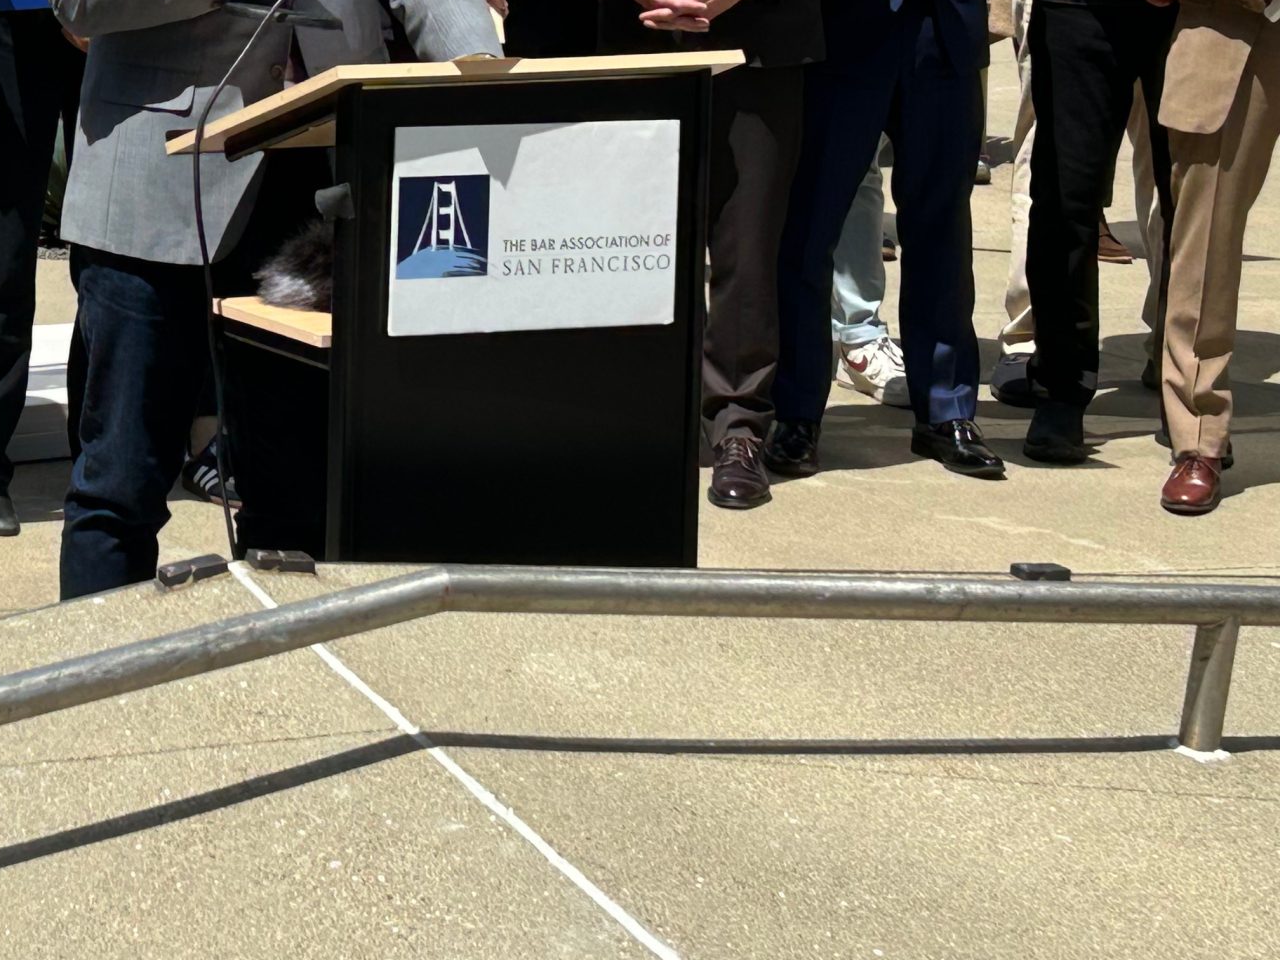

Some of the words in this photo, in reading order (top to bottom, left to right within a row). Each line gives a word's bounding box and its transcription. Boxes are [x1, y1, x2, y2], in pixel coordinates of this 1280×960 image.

[504, 239, 526, 253] THE
[531, 238, 556, 252] BAR
[559, 234, 650, 251] ASSOCIATION
[653, 233, 672, 247] OF
[502, 258, 542, 277] SAN
[551, 253, 671, 275] FRANCISCO
